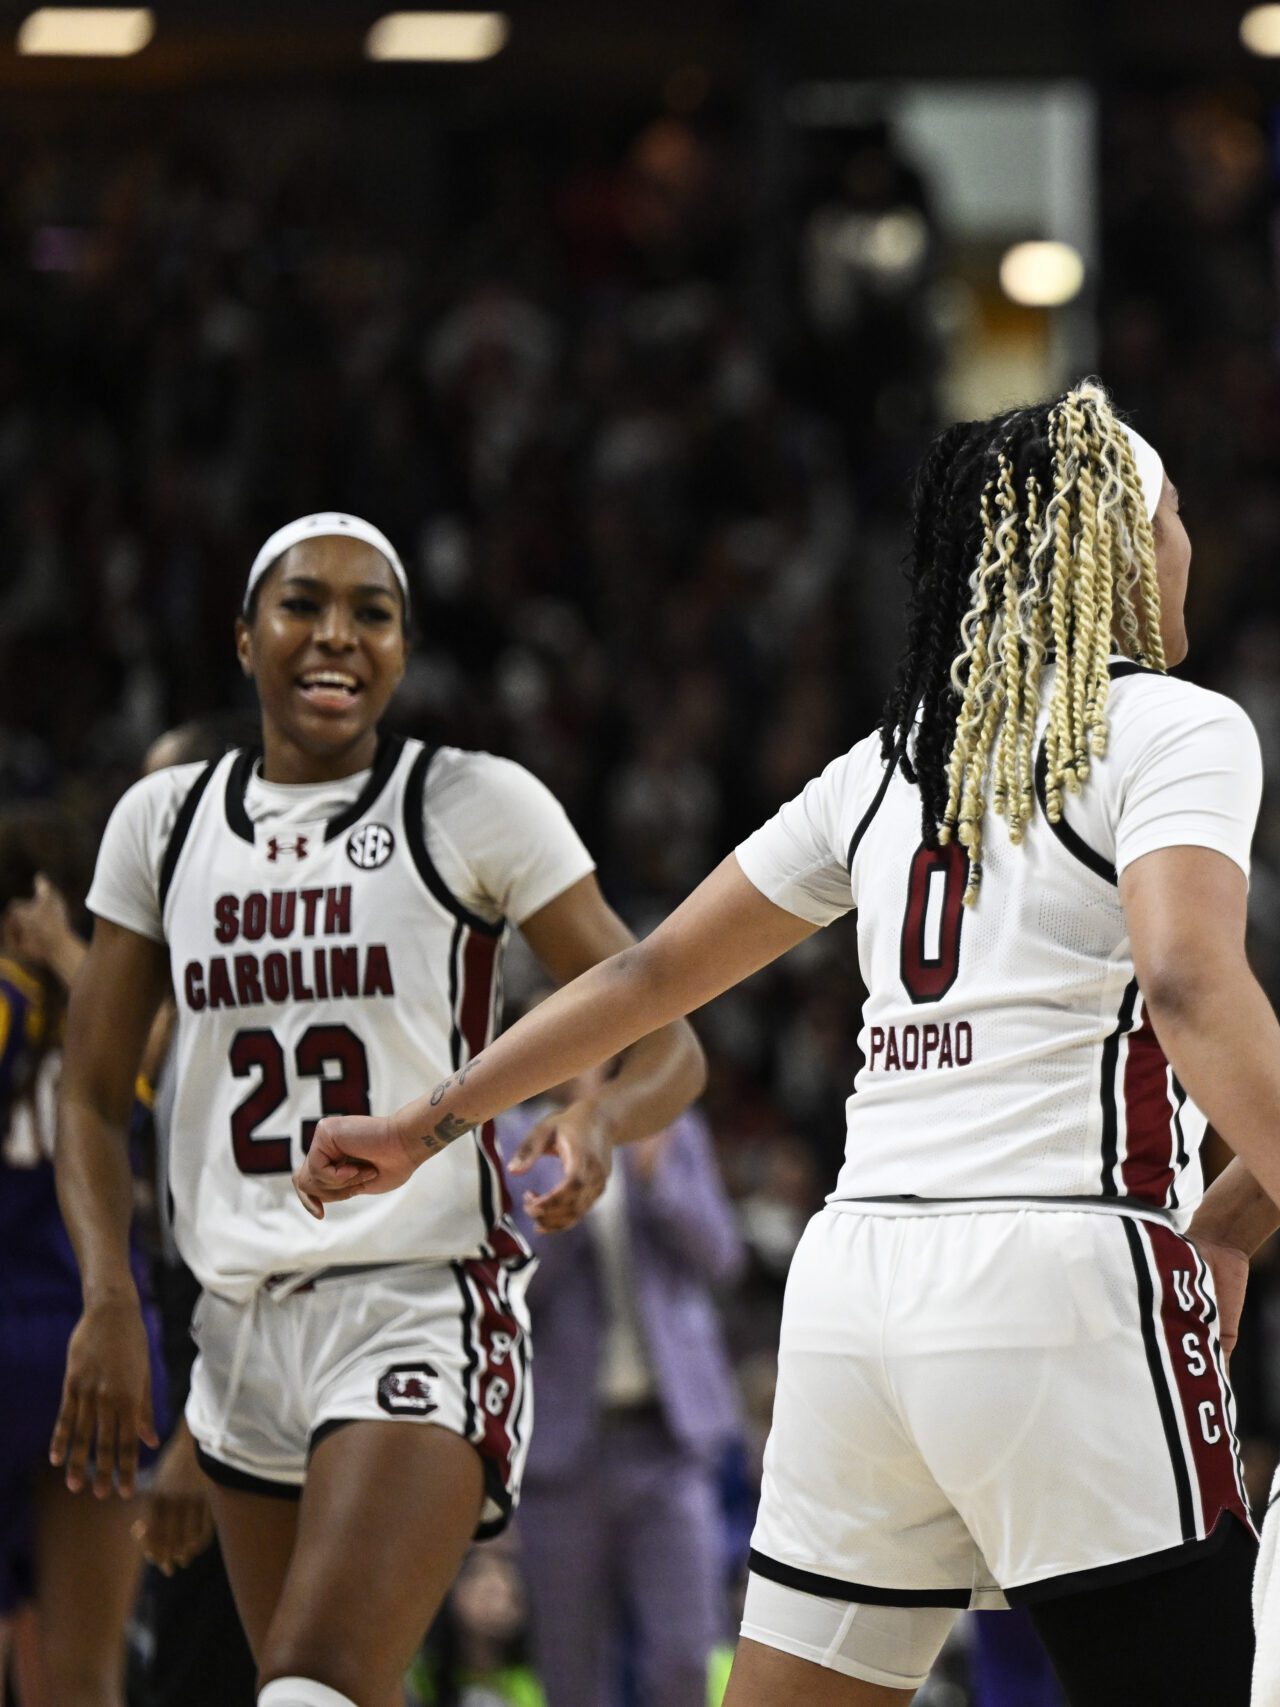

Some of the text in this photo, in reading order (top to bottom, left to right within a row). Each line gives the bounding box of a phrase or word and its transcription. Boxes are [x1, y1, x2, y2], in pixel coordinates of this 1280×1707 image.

[349, 824, 392, 868] SEC
[214, 884, 352, 945] SOUTH
[900, 838, 970, 1005] 0
[184, 945, 394, 1013] CAROLINA
[868, 1020, 974, 1072] PAOPAO
[229, 1023, 372, 1175] 23
[1172, 1269, 1221, 1445] USC
